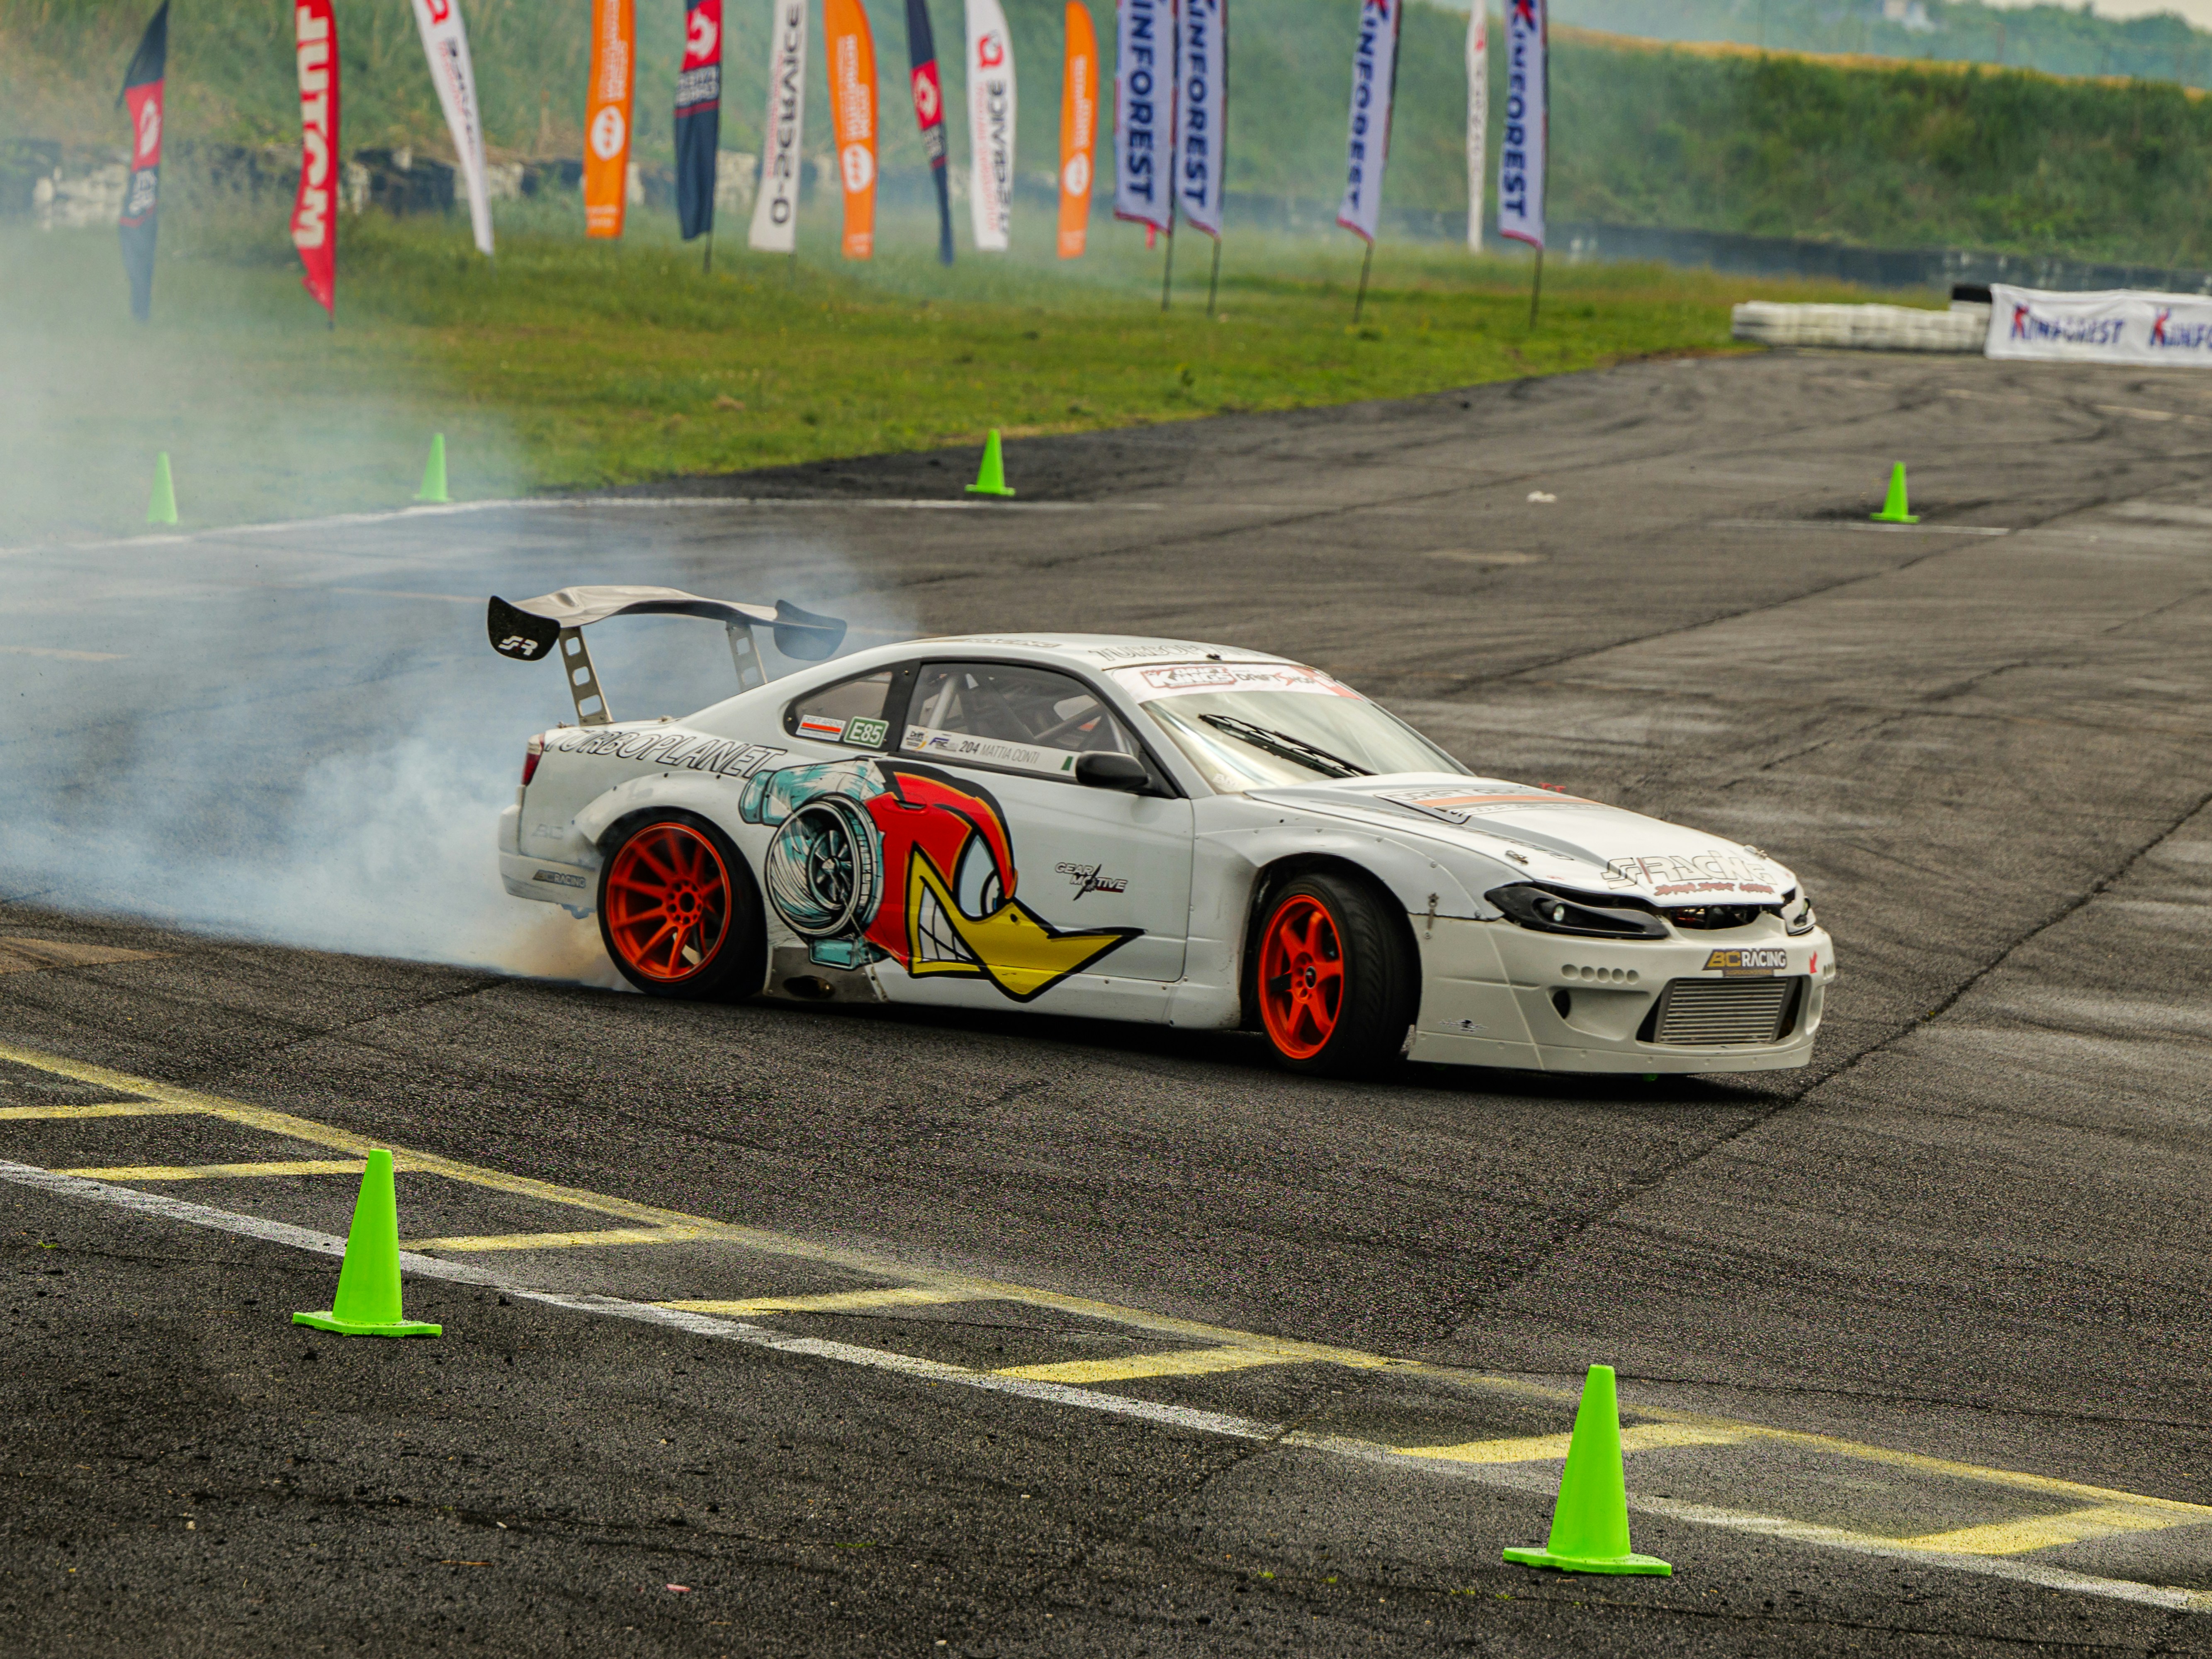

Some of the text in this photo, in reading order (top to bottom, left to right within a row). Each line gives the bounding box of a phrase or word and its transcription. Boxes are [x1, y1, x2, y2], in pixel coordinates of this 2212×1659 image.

[850, 722, 883, 743] E85
[545, 729, 788, 779] TURBOPLANET
[959, 740, 980, 755] 204
[979, 744, 1012, 759] MATTIA
[1011, 749, 1040, 764] CONTI
[1055, 862, 1095, 875] GEAR
[1742, 951, 1787, 967] RACING
